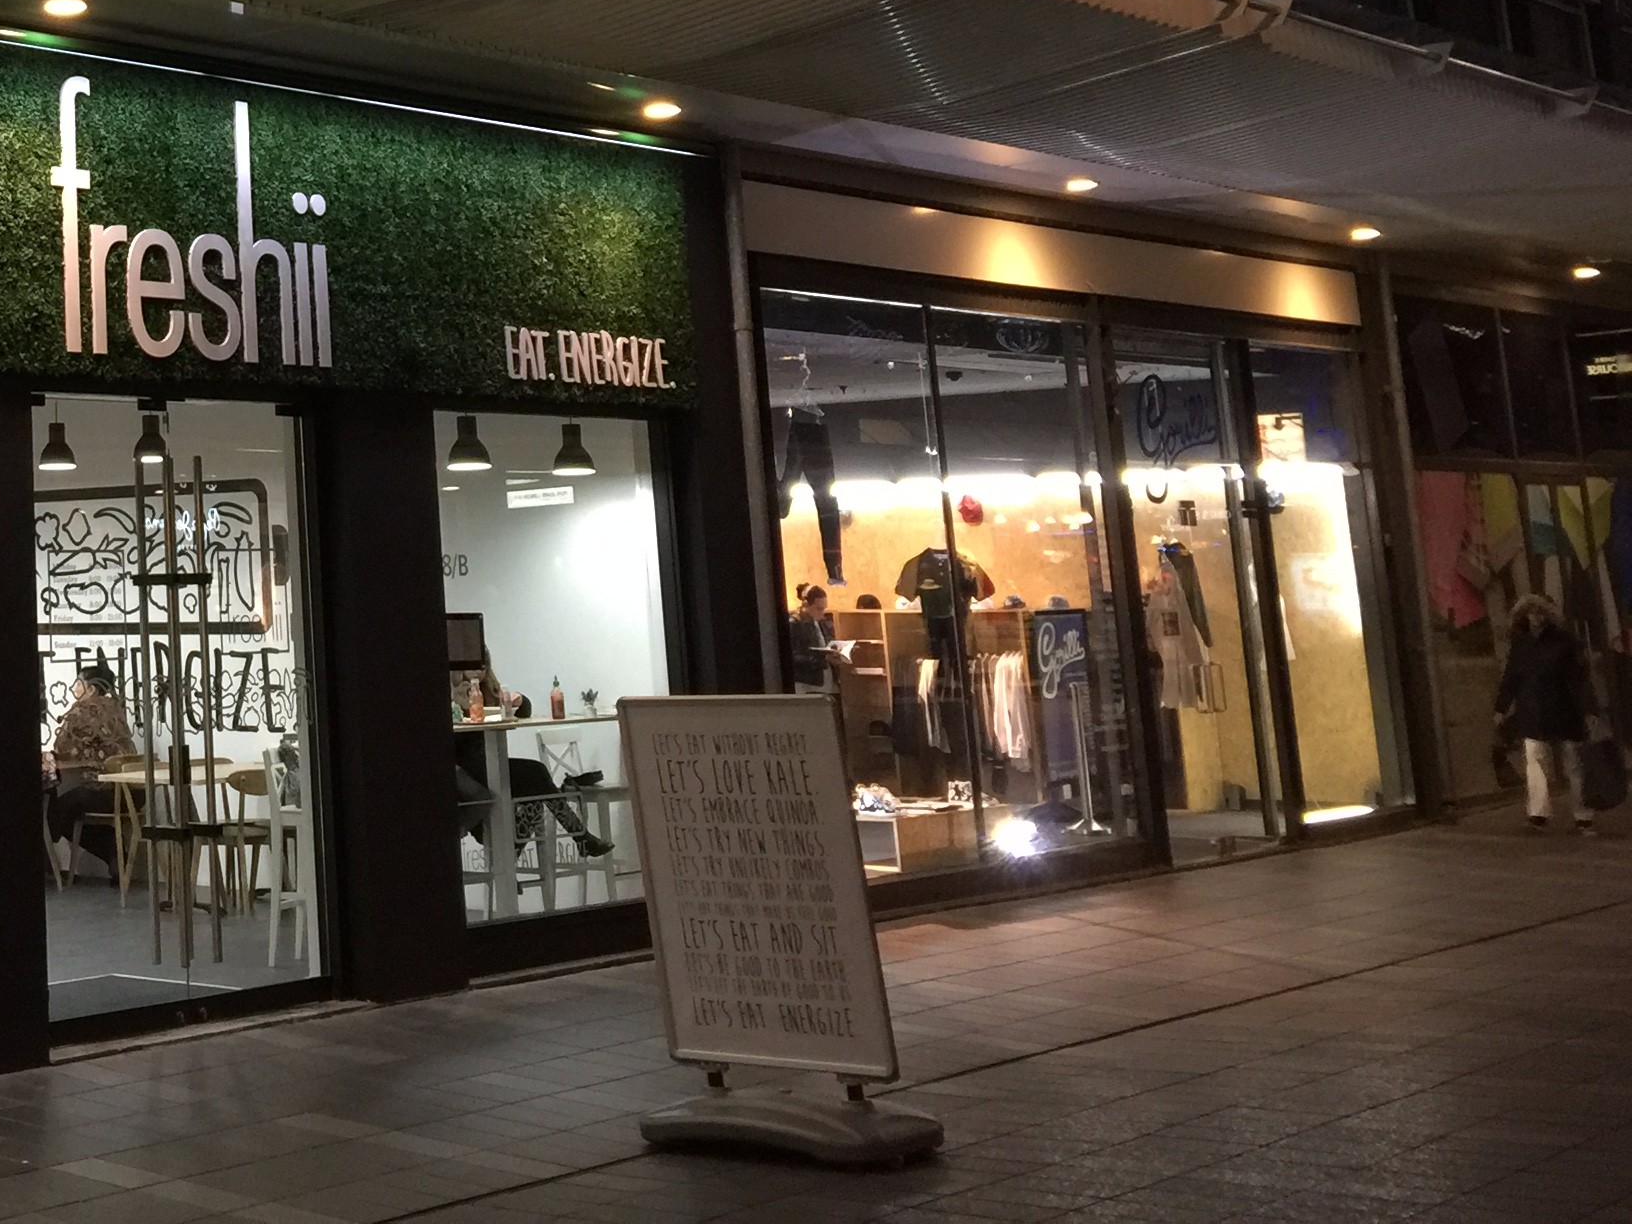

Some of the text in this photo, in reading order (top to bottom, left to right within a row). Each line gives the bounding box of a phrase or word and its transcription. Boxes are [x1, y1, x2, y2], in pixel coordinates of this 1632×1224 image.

[50, 75, 333, 368] freshii
[504, 325, 677, 389] EAT. ENERGIZE.
[655, 757, 705, 794] LET'S
[711, 758, 757, 795] LOVE
[661, 796, 697, 823] LET'S
[701, 796, 761, 825] EMBRACE
[666, 826, 703, 853] LET'S
[706, 826, 732, 854] TRY
[737, 827, 766, 855] NEW
[703, 855, 722, 877] TRY
[680, 917, 724, 950] LET'S
[729, 920, 760, 952] EAT
[769, 921, 803, 955] AND
[693, 997, 855, 1039] LET'S EAT ENERGIZE
